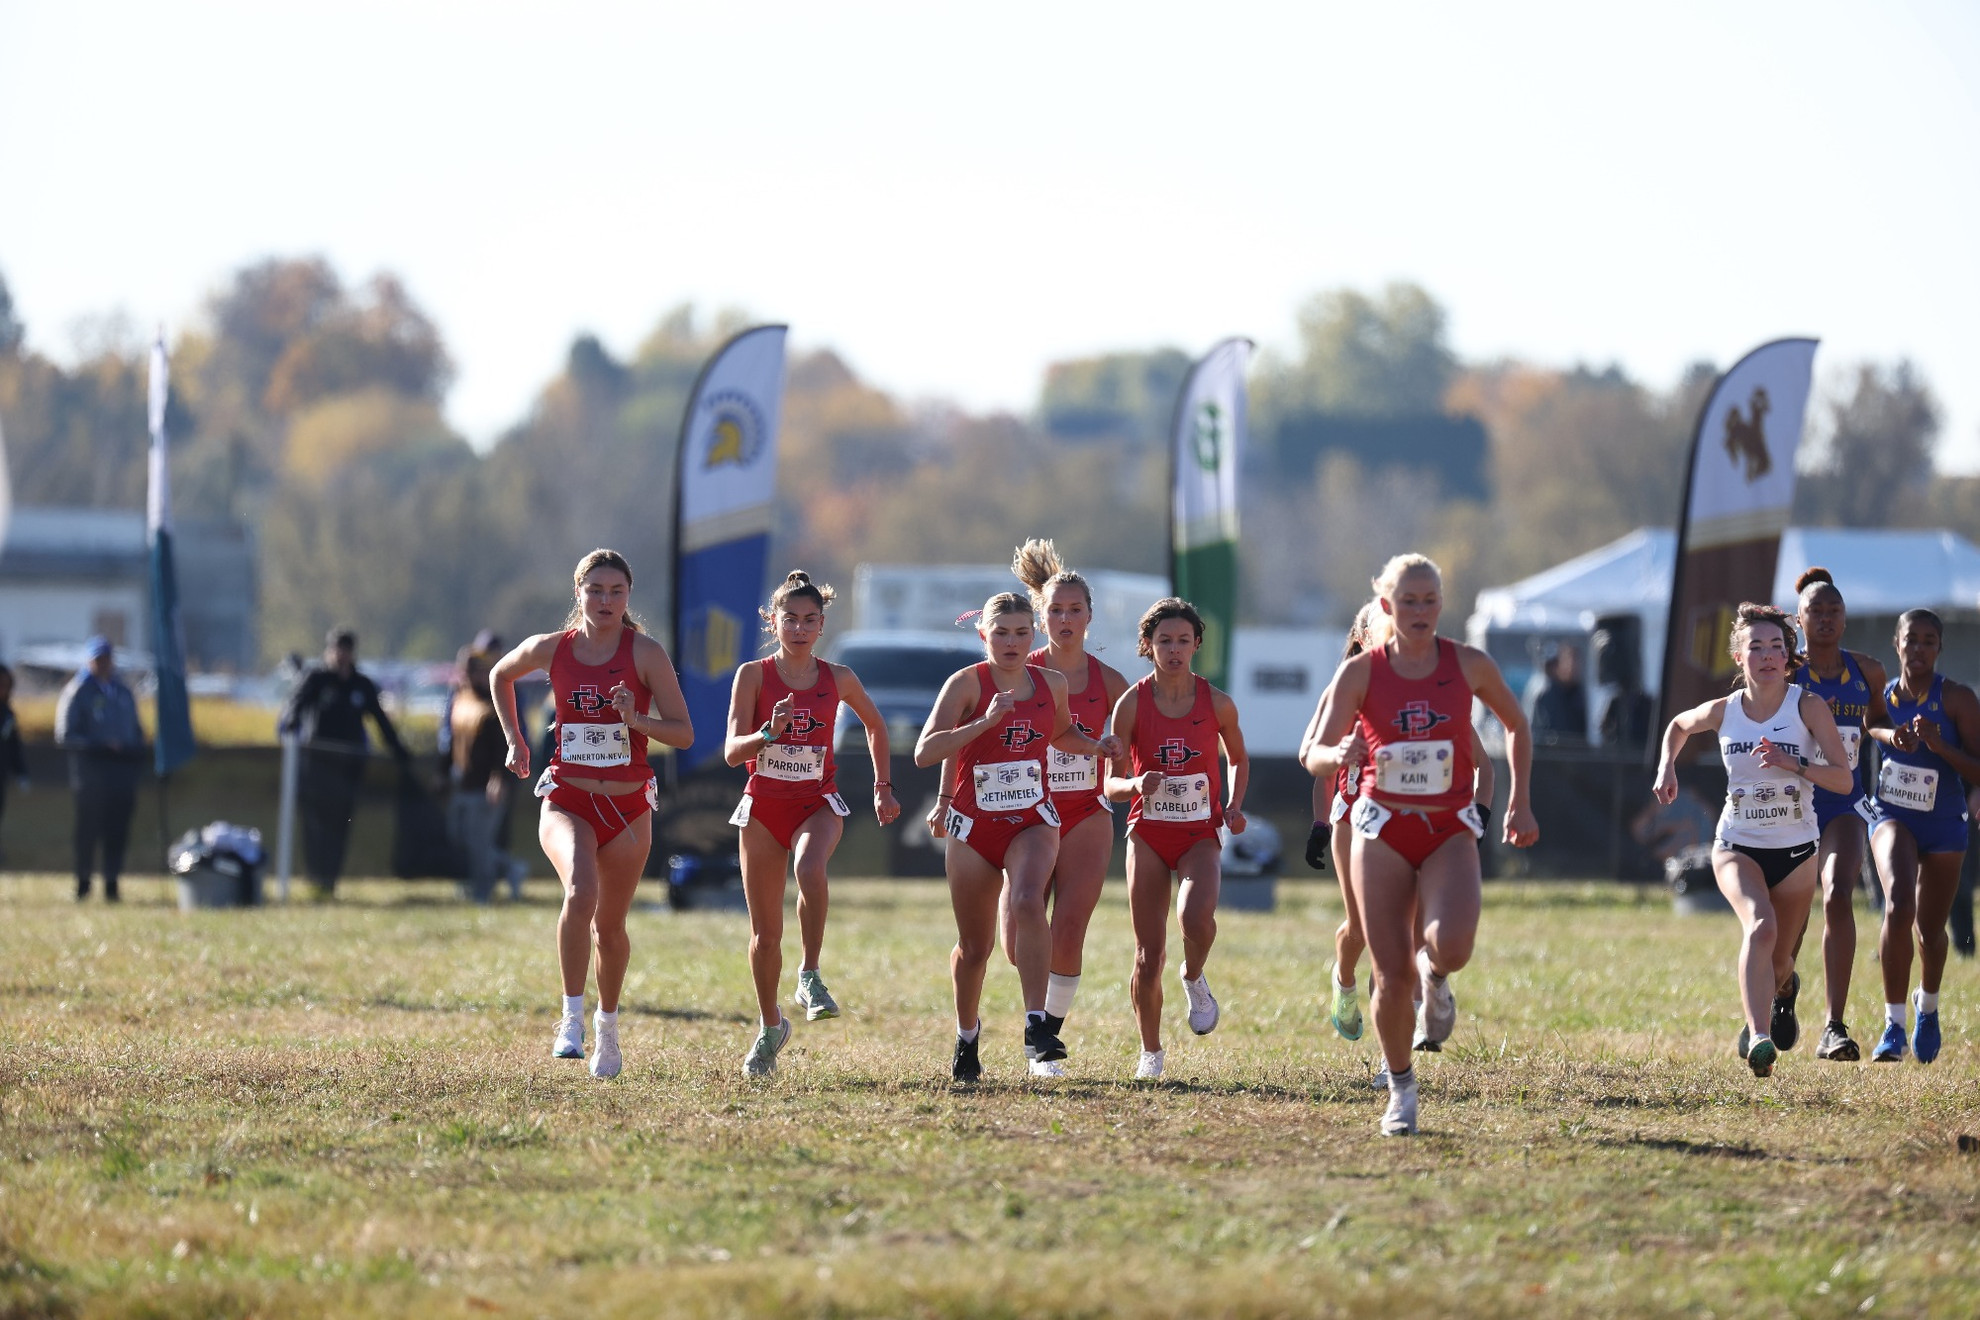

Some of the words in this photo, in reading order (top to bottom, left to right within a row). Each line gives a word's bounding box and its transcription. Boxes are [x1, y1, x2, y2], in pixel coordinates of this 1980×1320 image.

[1724, 741, 1754, 755] UTAH
[767, 758, 813, 773] PARRONE
[1047, 771, 1085, 782] PERETTI
[1401, 773, 1428, 784] KAIN
[1885, 785, 1928, 803] CAMPBELL
[1155, 801, 1197, 812] CABELLO
[1745, 807, 1788, 819] LUDLOW
